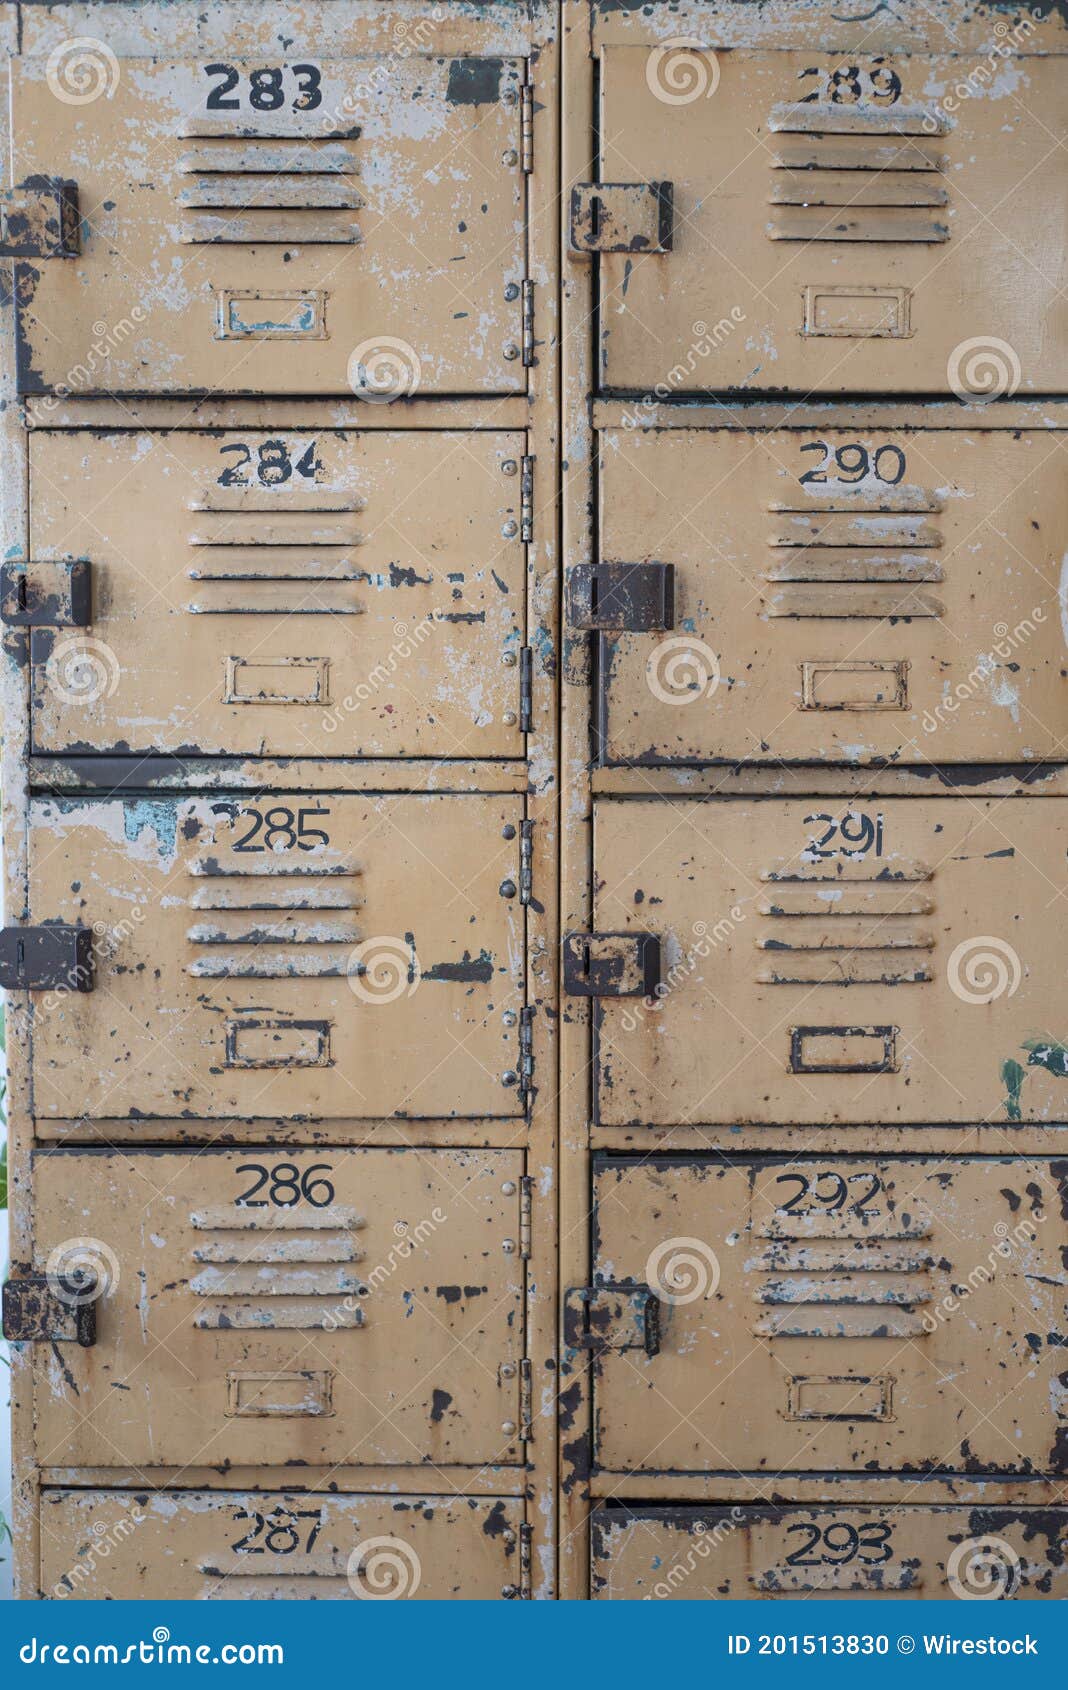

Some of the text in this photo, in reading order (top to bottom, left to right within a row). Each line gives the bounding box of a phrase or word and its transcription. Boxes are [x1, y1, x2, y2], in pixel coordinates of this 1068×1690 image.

[203, 63, 323, 112] 283
[797, 66, 902, 105] 289
[217, 440, 324, 487] 284
[799, 443, 906, 485] 290
[232, 807, 331, 853] 285
[803, 812, 884, 858] 291
[234, 1163, 335, 1208] 286
[776, 1172, 882, 1217] 292
[232, 1505, 323, 1554] 287
[785, 1522, 895, 1567] 293
